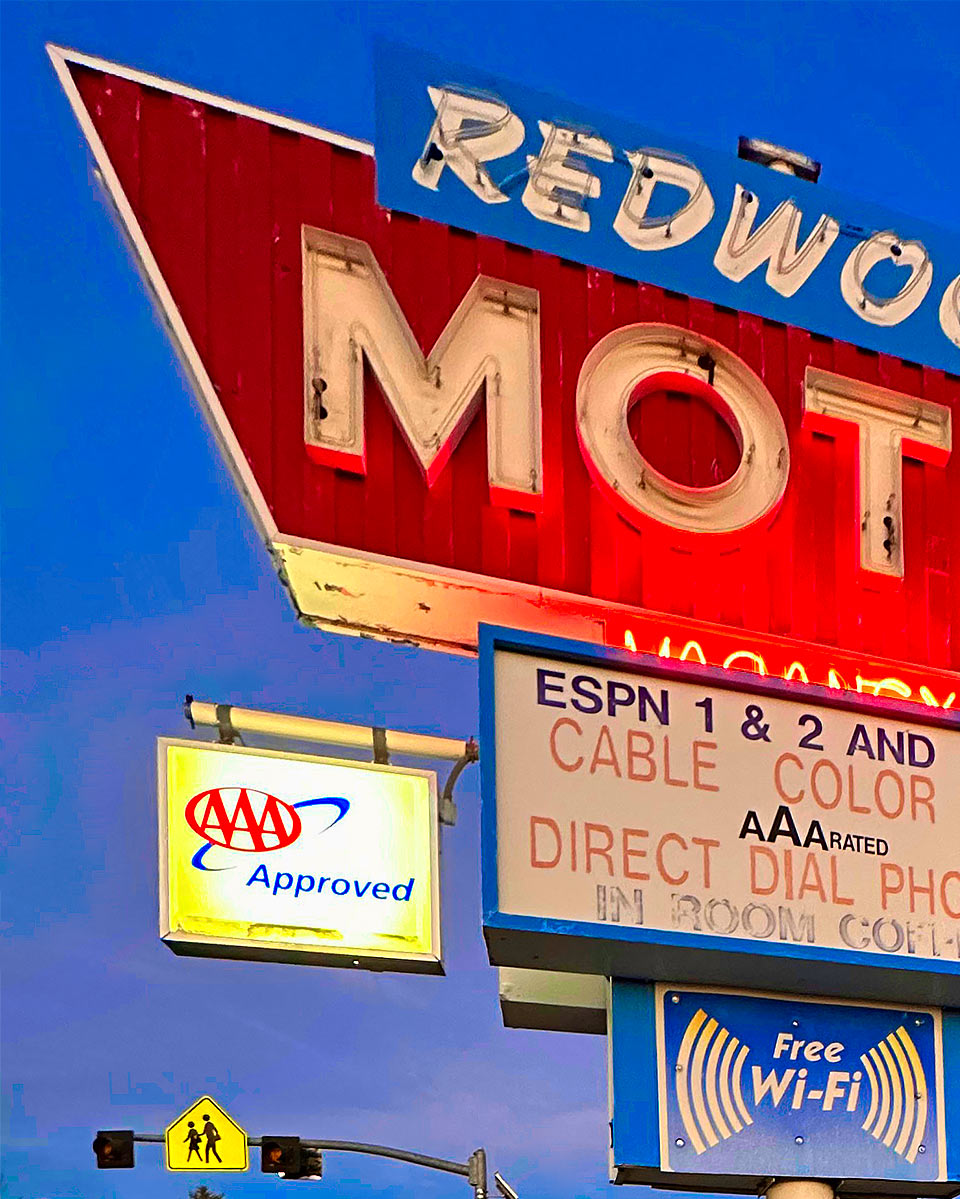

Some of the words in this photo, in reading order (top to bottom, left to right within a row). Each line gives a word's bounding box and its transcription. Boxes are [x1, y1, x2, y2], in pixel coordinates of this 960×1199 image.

[536, 668, 669, 726] ESPN
[695, 697, 714, 732] 1
[741, 705, 771, 742] &
[798, 714, 824, 752] 2
[846, 724, 936, 768] AND
[550, 717, 720, 792] CABLE
[774, 752, 935, 824] COLOR
[189, 787, 298, 852] AAA
[246, 864, 415, 902] Approved
[530, 816, 721, 889] DIRECT
[750, 845, 854, 906] DIAL
[596, 884, 644, 925] IN
[671, 893, 815, 944] ROOM
[773, 1033, 844, 1063] Free
[752, 1066, 862, 1112] Wi-Fi
